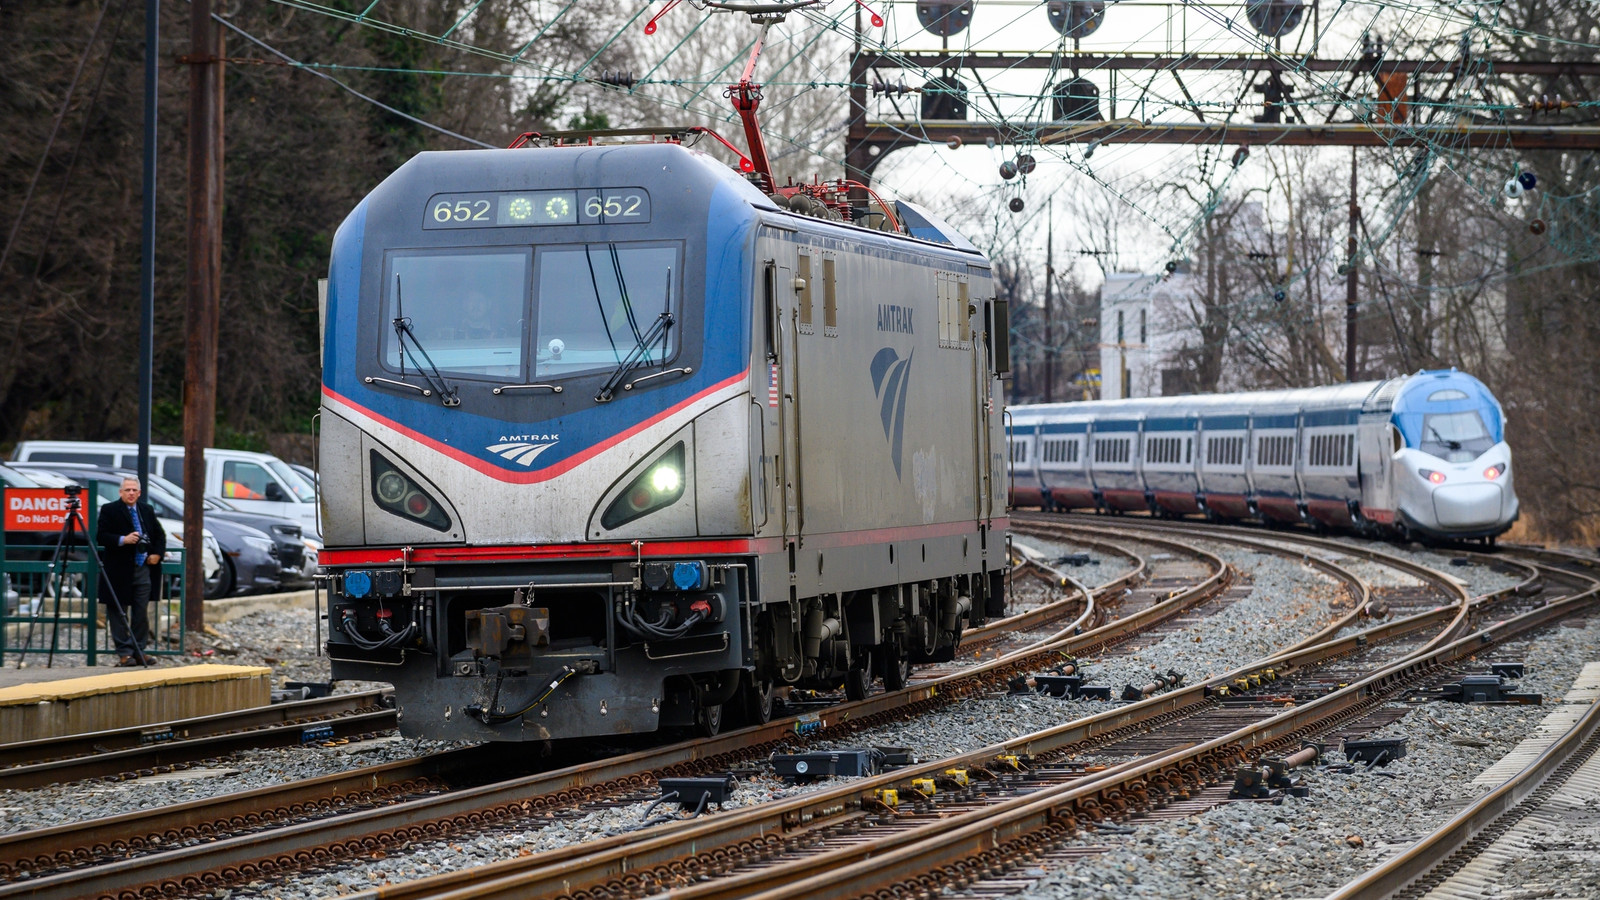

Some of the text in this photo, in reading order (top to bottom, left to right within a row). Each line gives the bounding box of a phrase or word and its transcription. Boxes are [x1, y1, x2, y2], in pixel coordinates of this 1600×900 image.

[433, 200, 491, 222] 652
[584, 195, 642, 217] 652
[877, 303, 914, 335] AMTRAK
[499, 434, 559, 442] AMTRAK
[16, 514, 31, 523] Do
[32, 514, 50, 523] Not
